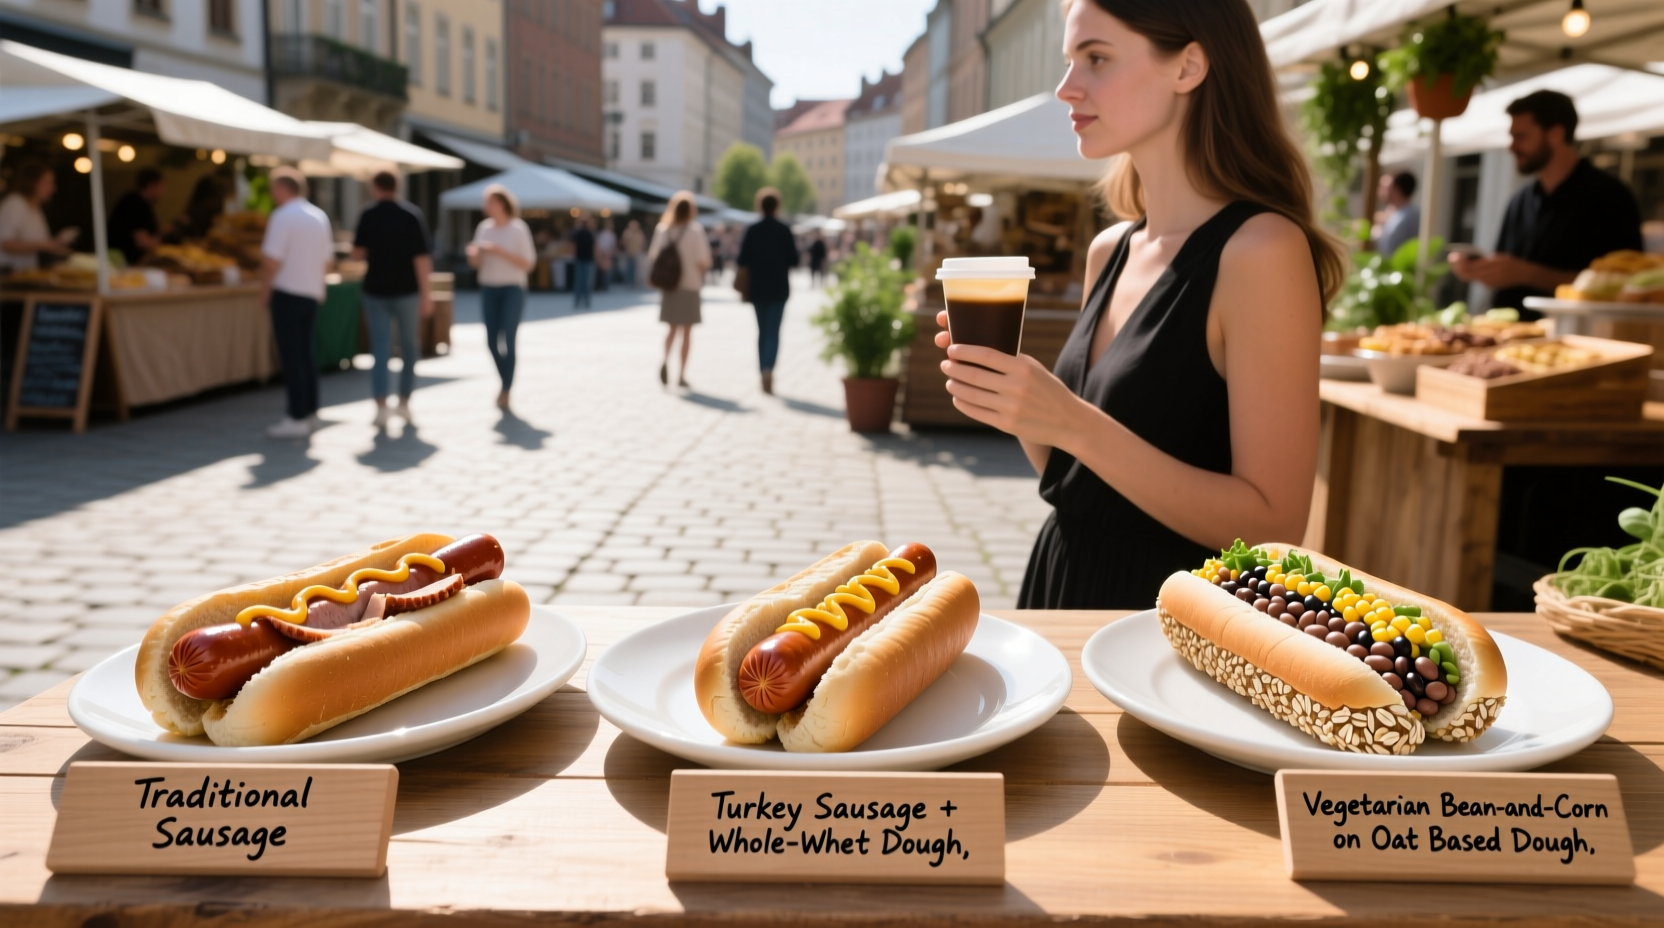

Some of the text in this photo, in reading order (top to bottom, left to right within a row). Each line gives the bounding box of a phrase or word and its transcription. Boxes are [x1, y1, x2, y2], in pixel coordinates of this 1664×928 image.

[134, 775, 313, 810] Traditional
[710, 790, 958, 832] Turkey Sausage +
[1302, 790, 1609, 827] Vegetarian Bean-and-Corn
[151, 816, 287, 862] Sausage
[708, 826, 970, 868] Whole-Whet Dough,
[1333, 833, 1361, 850] on
[1371, 824, 1419, 851] Oat
[1428, 824, 1502, 853] Based
